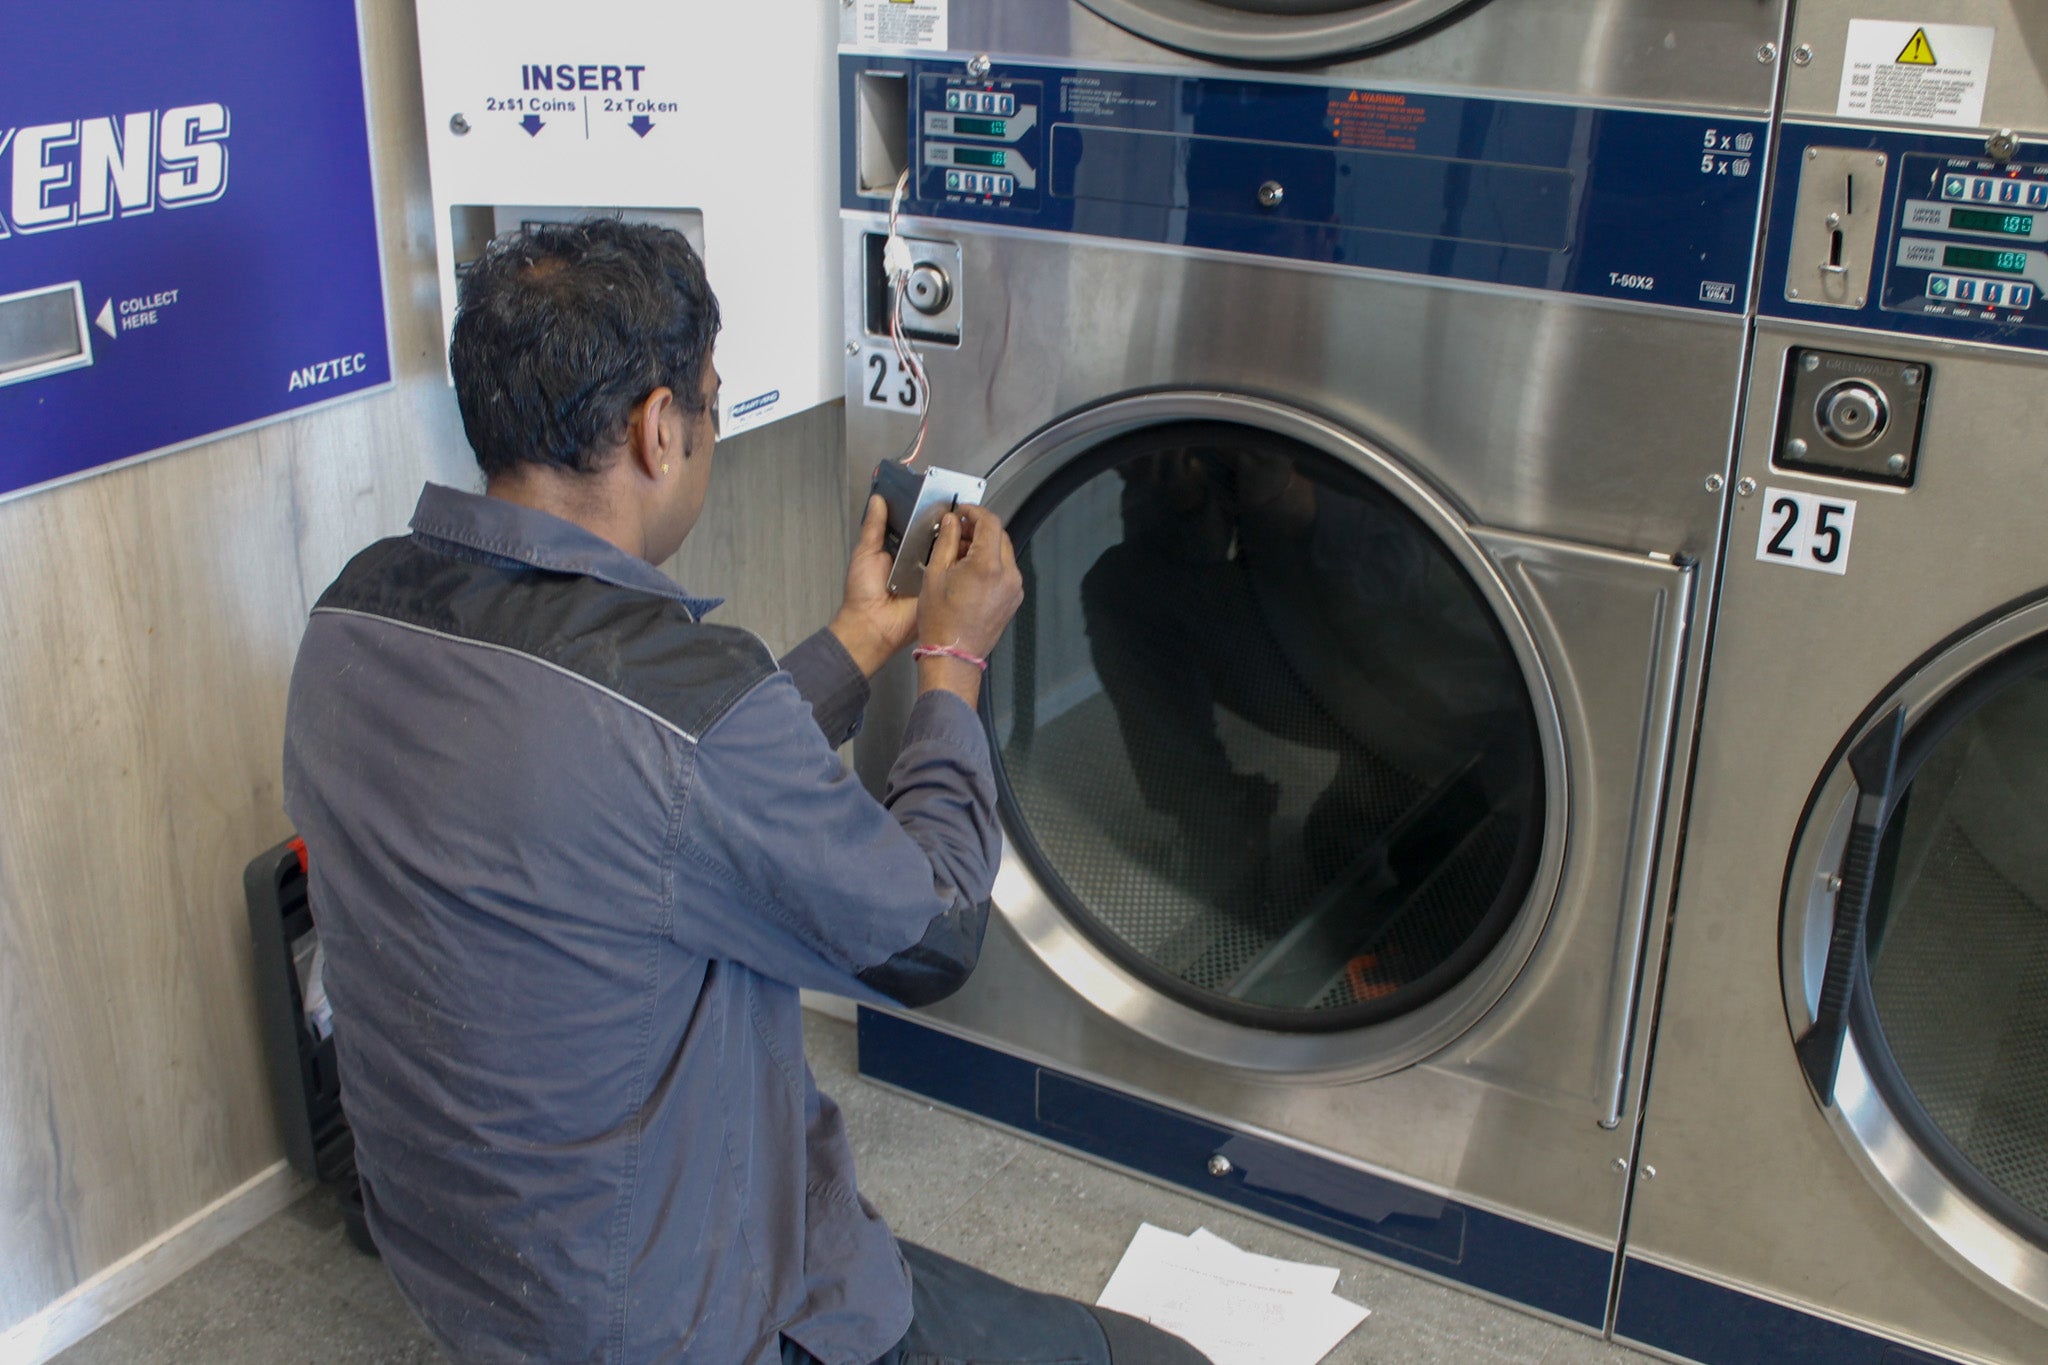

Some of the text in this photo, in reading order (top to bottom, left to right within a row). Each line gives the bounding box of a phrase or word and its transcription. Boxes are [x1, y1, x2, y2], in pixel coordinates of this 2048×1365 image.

[522, 64, 646, 91] INSERT
[529, 97, 576, 112] Coins
[1361, 92, 1406, 106] WARNING
[1703, 129, 1731, 150] 5 x
[1701, 154, 1728, 175] 5 x
[1947, 159, 1970, 168] START
[1977, 161, 1995, 170] HIGH
[0, 102, 231, 240] ENS
[1914, 207, 1941, 216] UPPER
[1912, 215, 1941, 225] DRYER
[1907, 245, 1936, 254] LOWER
[1906, 252, 1934, 262] DRYER
[1609, 272, 1654, 290] T-50X2
[1706, 290, 1726, 300] USA
[120, 289, 179, 315] COLLECT
[1924, 304, 1946, 314] START
[1953, 308, 1971, 317] HIGH
[121, 310, 158, 331] HERE
[1980, 311, 1996, 320] MED
[2007, 315, 2024, 323] LOW
[288, 352, 367, 393] ANZTEC
[1766, 498, 1845, 563] 25
